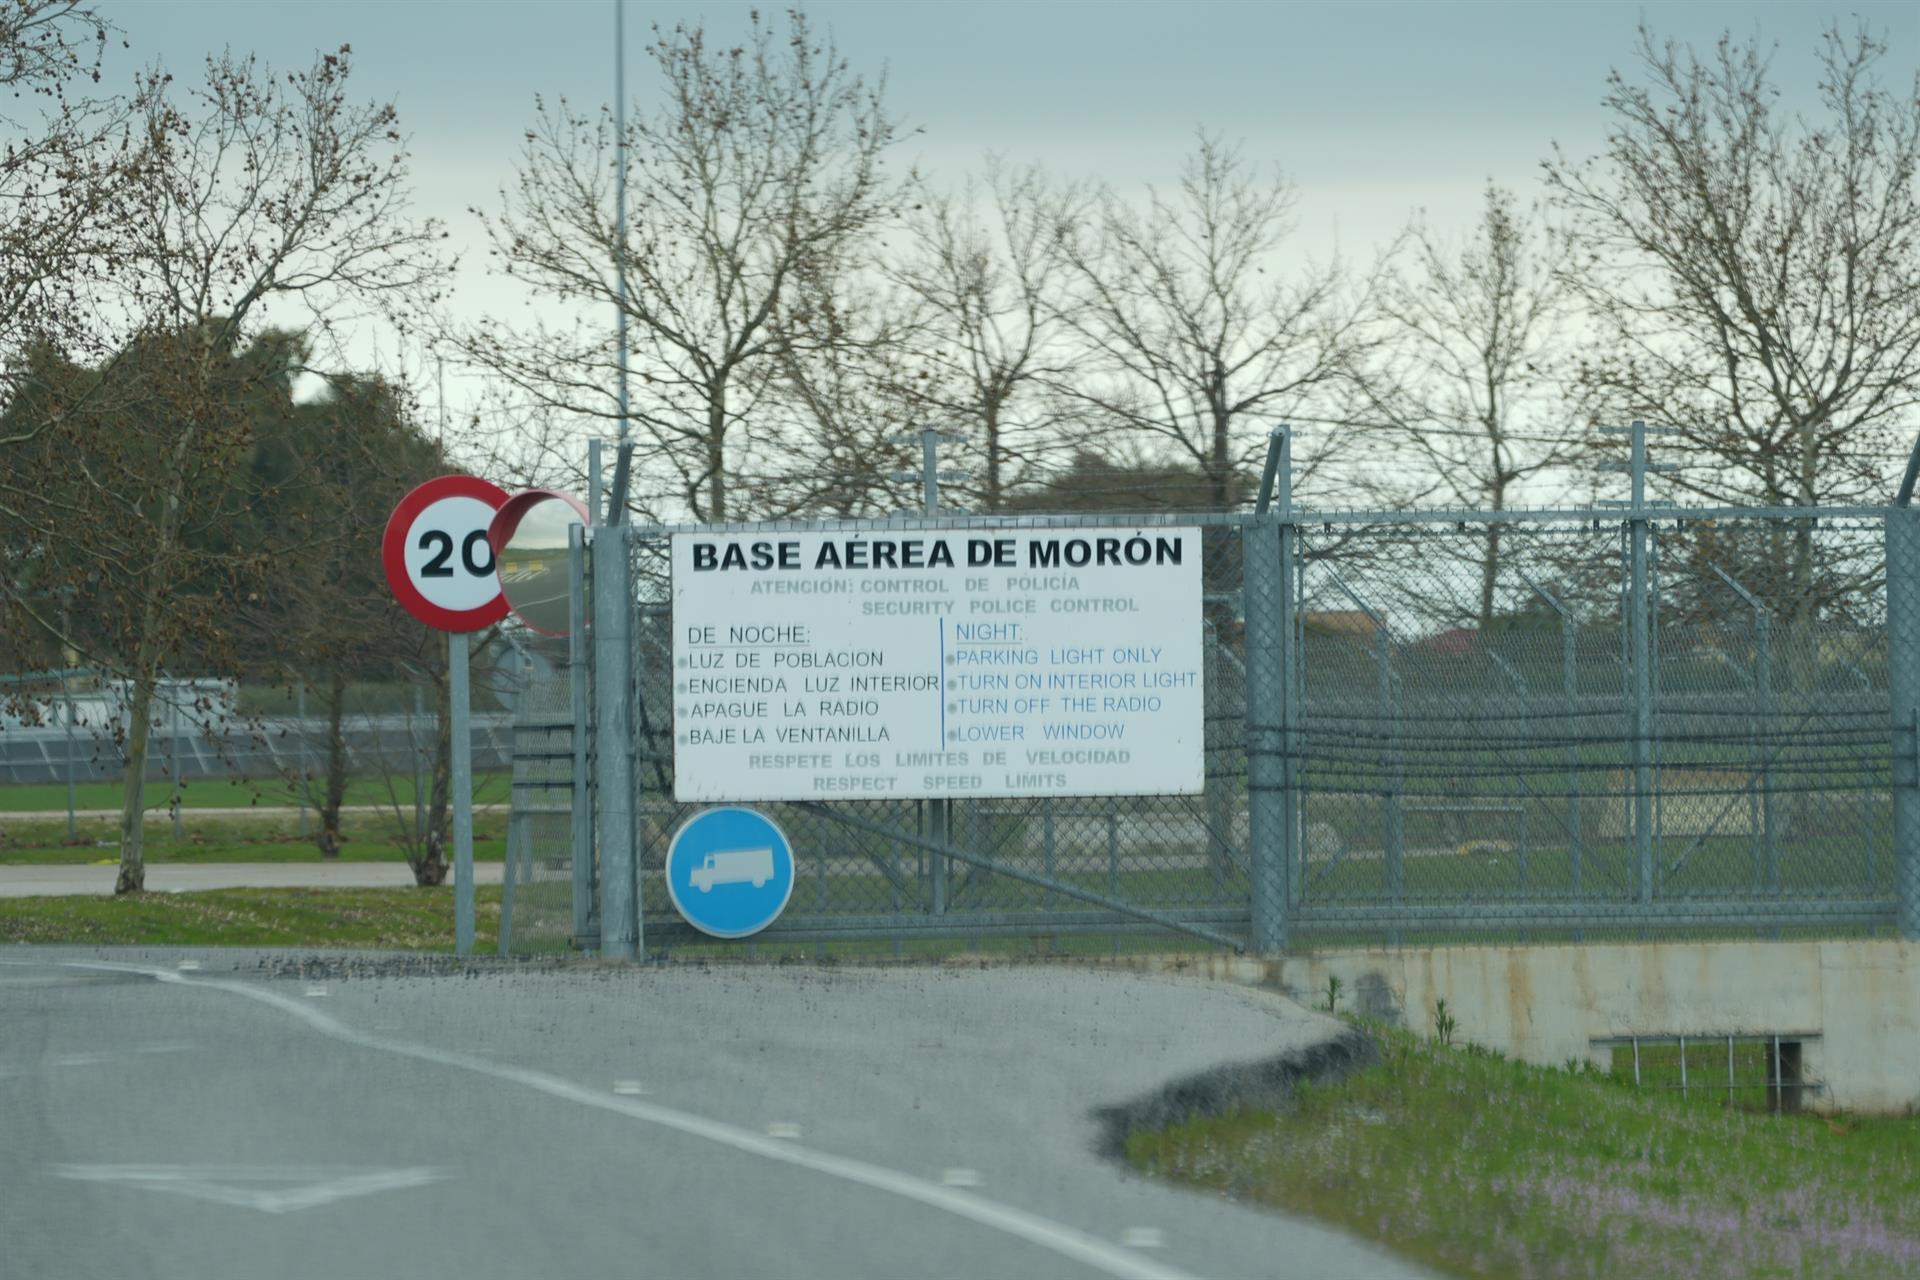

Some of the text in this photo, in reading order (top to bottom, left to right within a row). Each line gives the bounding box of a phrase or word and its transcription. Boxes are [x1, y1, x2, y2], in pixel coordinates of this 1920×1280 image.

[418, 529, 496, 577] 20
[693, 532, 1182, 572] BASE AÉREA DE MORÓN
[861, 578, 949, 593] CONTROL
[965, 578, 989, 592] DE
[862, 598, 1139, 616] SECURITY POLICE CONTROL
[688, 625, 810, 644] DE NOCHE:
[956, 623, 1023, 640] NIGHT:
[689, 653, 724, 669] LUZ
[736, 653, 760, 668] DE
[956, 648, 1162, 666] PARKING LIGHT ONLY
[689, 675, 939, 694] ENCIENDA LUZ INTERIOR
[958, 671, 1197, 690] TURN ON INTERIOR LIGHT
[690, 701, 879, 718] APAGUE LA RADIO
[957, 696, 1161, 714] TURN OFF THE RADIO
[690, 727, 890, 745] BAJE LA VENTANILLA
[957, 724, 1125, 742] LOWER WINDOW
[749, 750, 1131, 769] RESPETE LOS LIMITES DE VELOCIDAD
[813, 773, 1067, 791] RESPECT SPEED LIMITS
